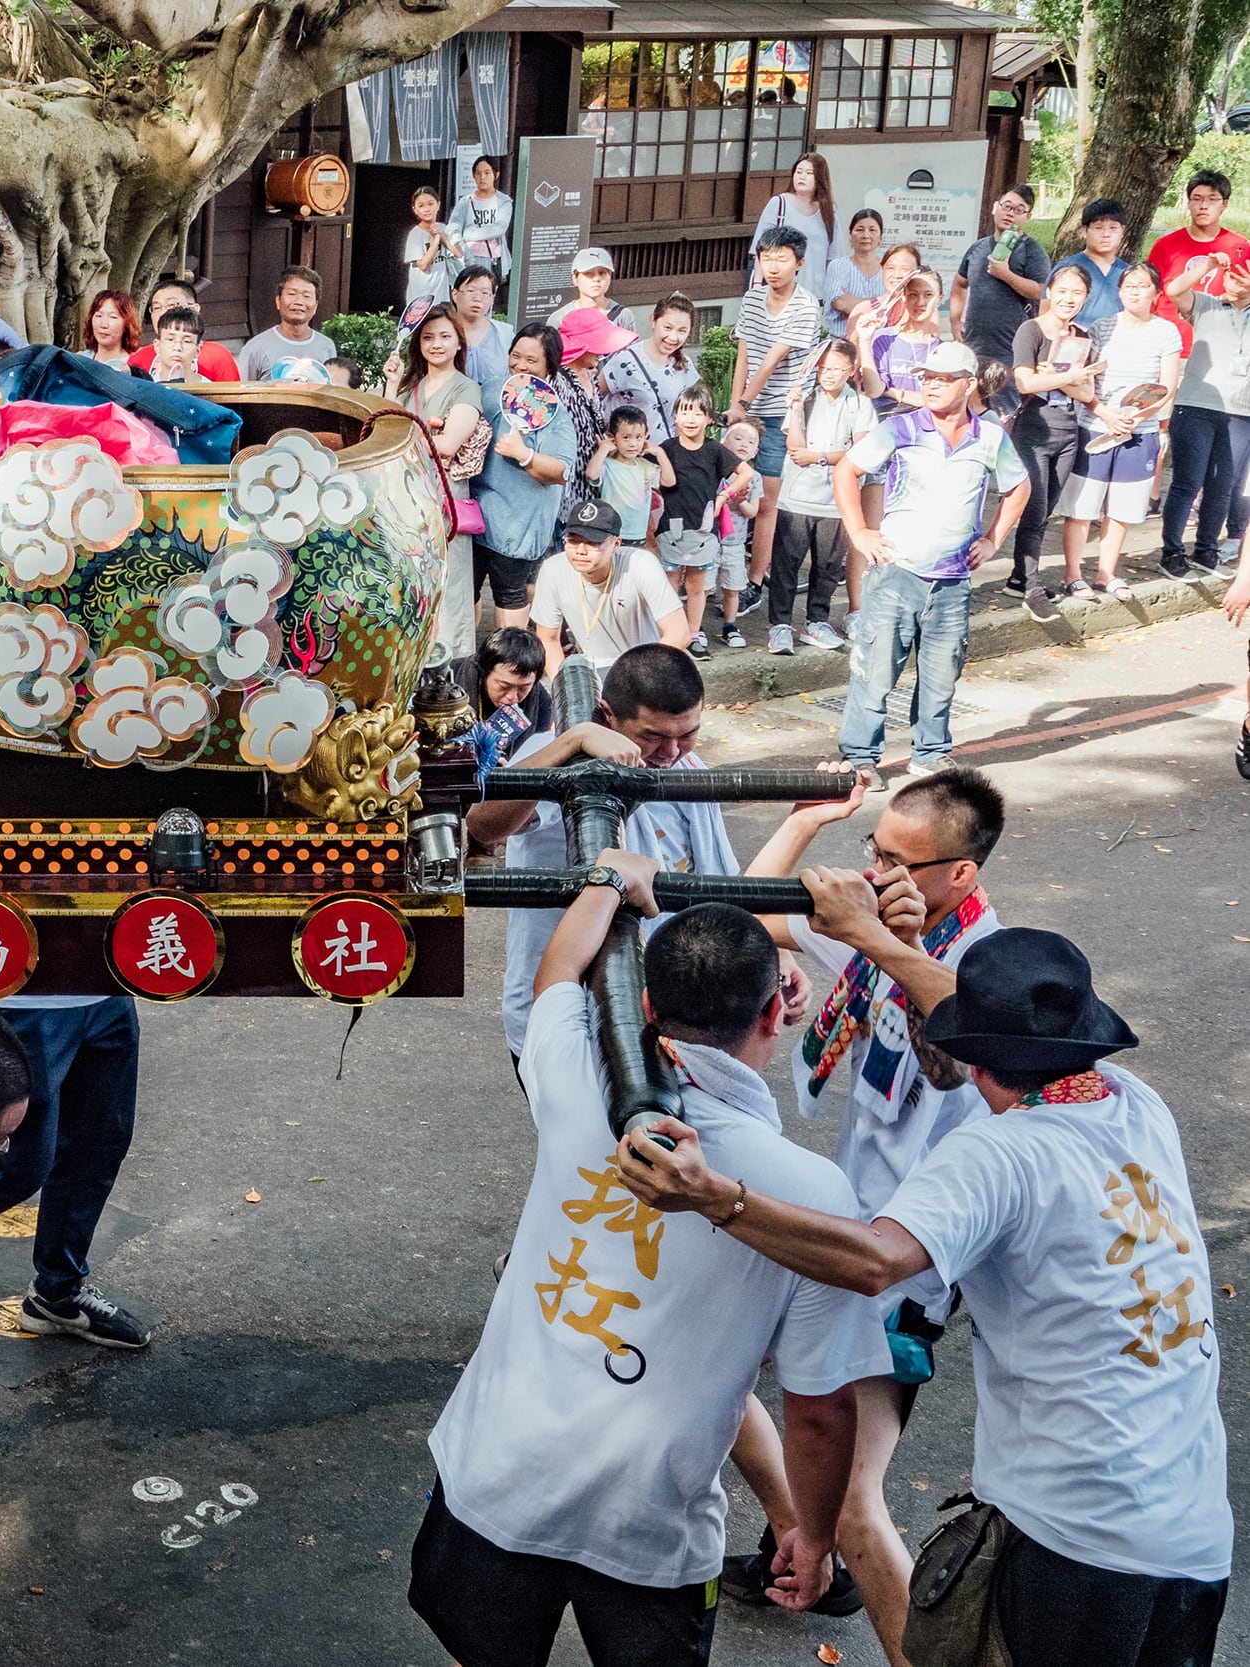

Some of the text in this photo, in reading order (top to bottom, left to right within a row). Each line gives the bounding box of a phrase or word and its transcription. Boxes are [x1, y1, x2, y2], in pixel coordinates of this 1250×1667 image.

[473, 209, 496, 226] SICK
[893, 213, 948, 223] 定時導覽服務
[1100, 1163, 1206, 1367] 我扛
